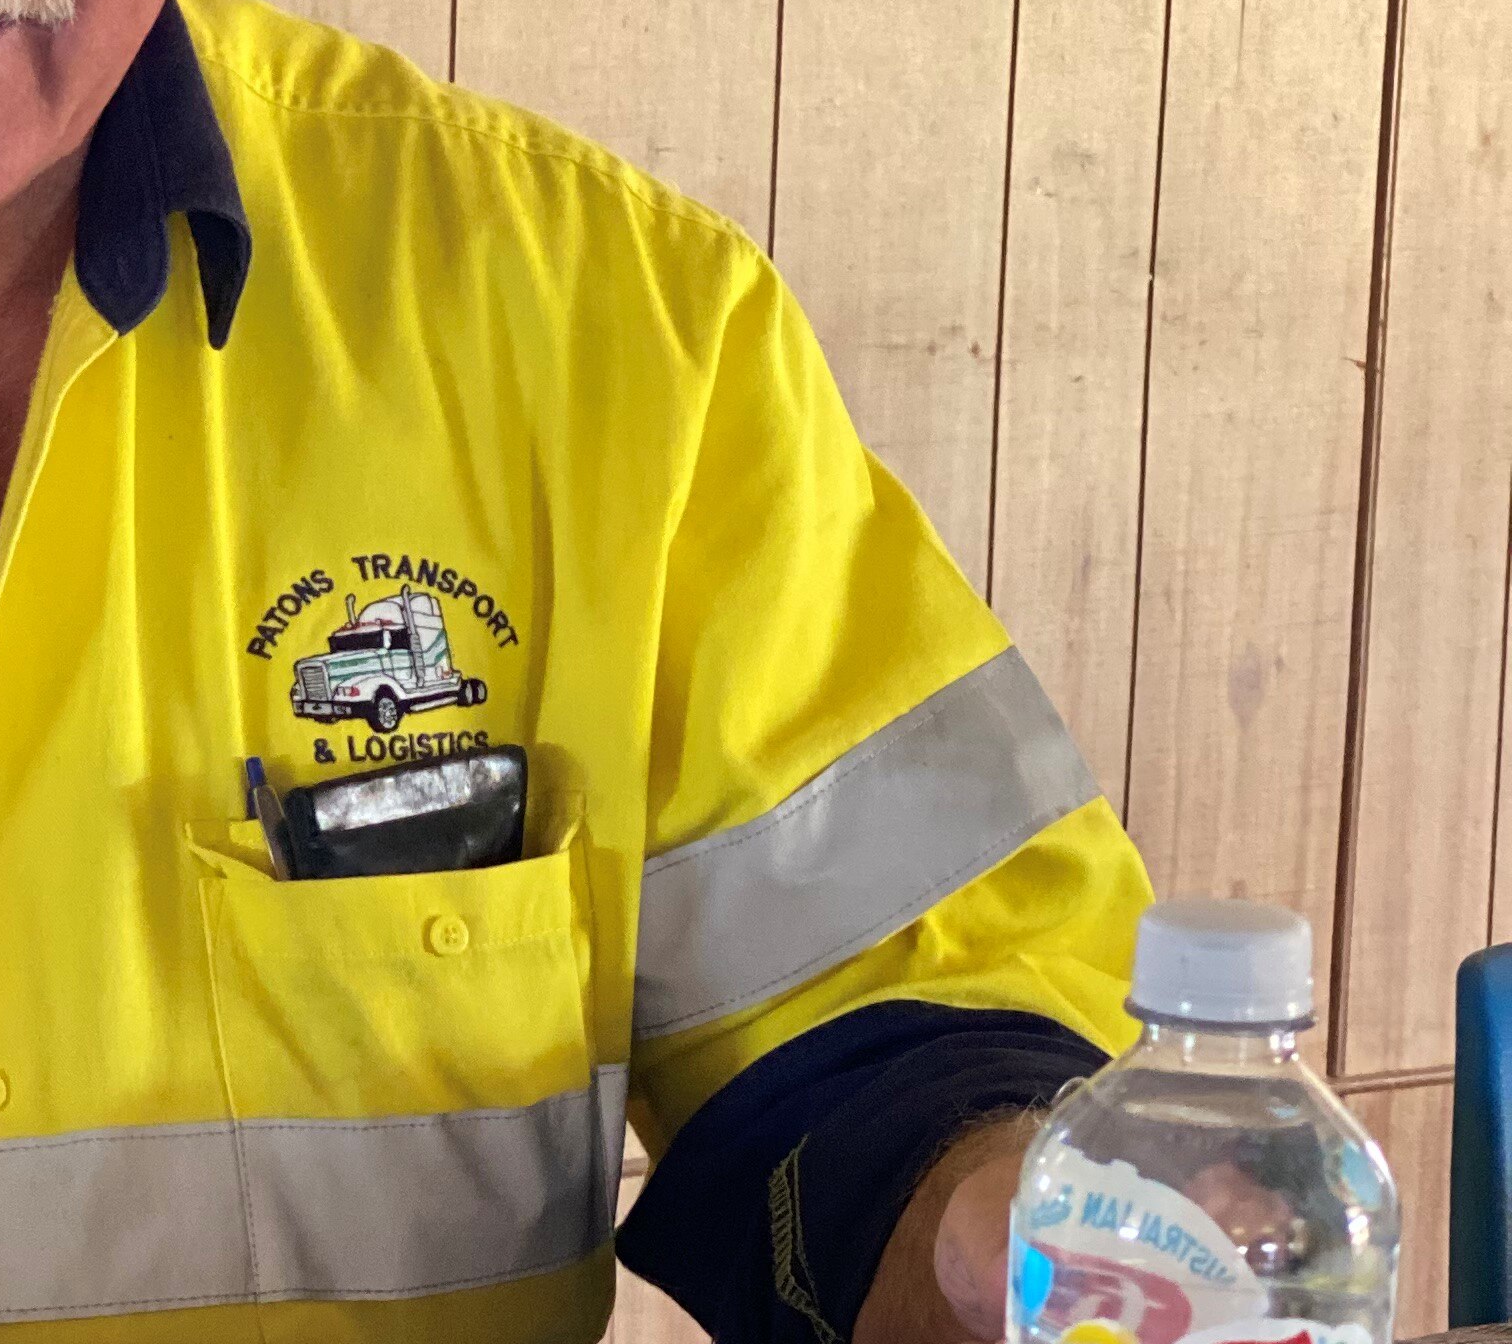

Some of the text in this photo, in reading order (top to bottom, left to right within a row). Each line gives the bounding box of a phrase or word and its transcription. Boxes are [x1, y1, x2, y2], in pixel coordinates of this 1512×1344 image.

[246, 554, 519, 660] PATONS TRANSPORT
[313, 731, 489, 764] & LOGISTICS
